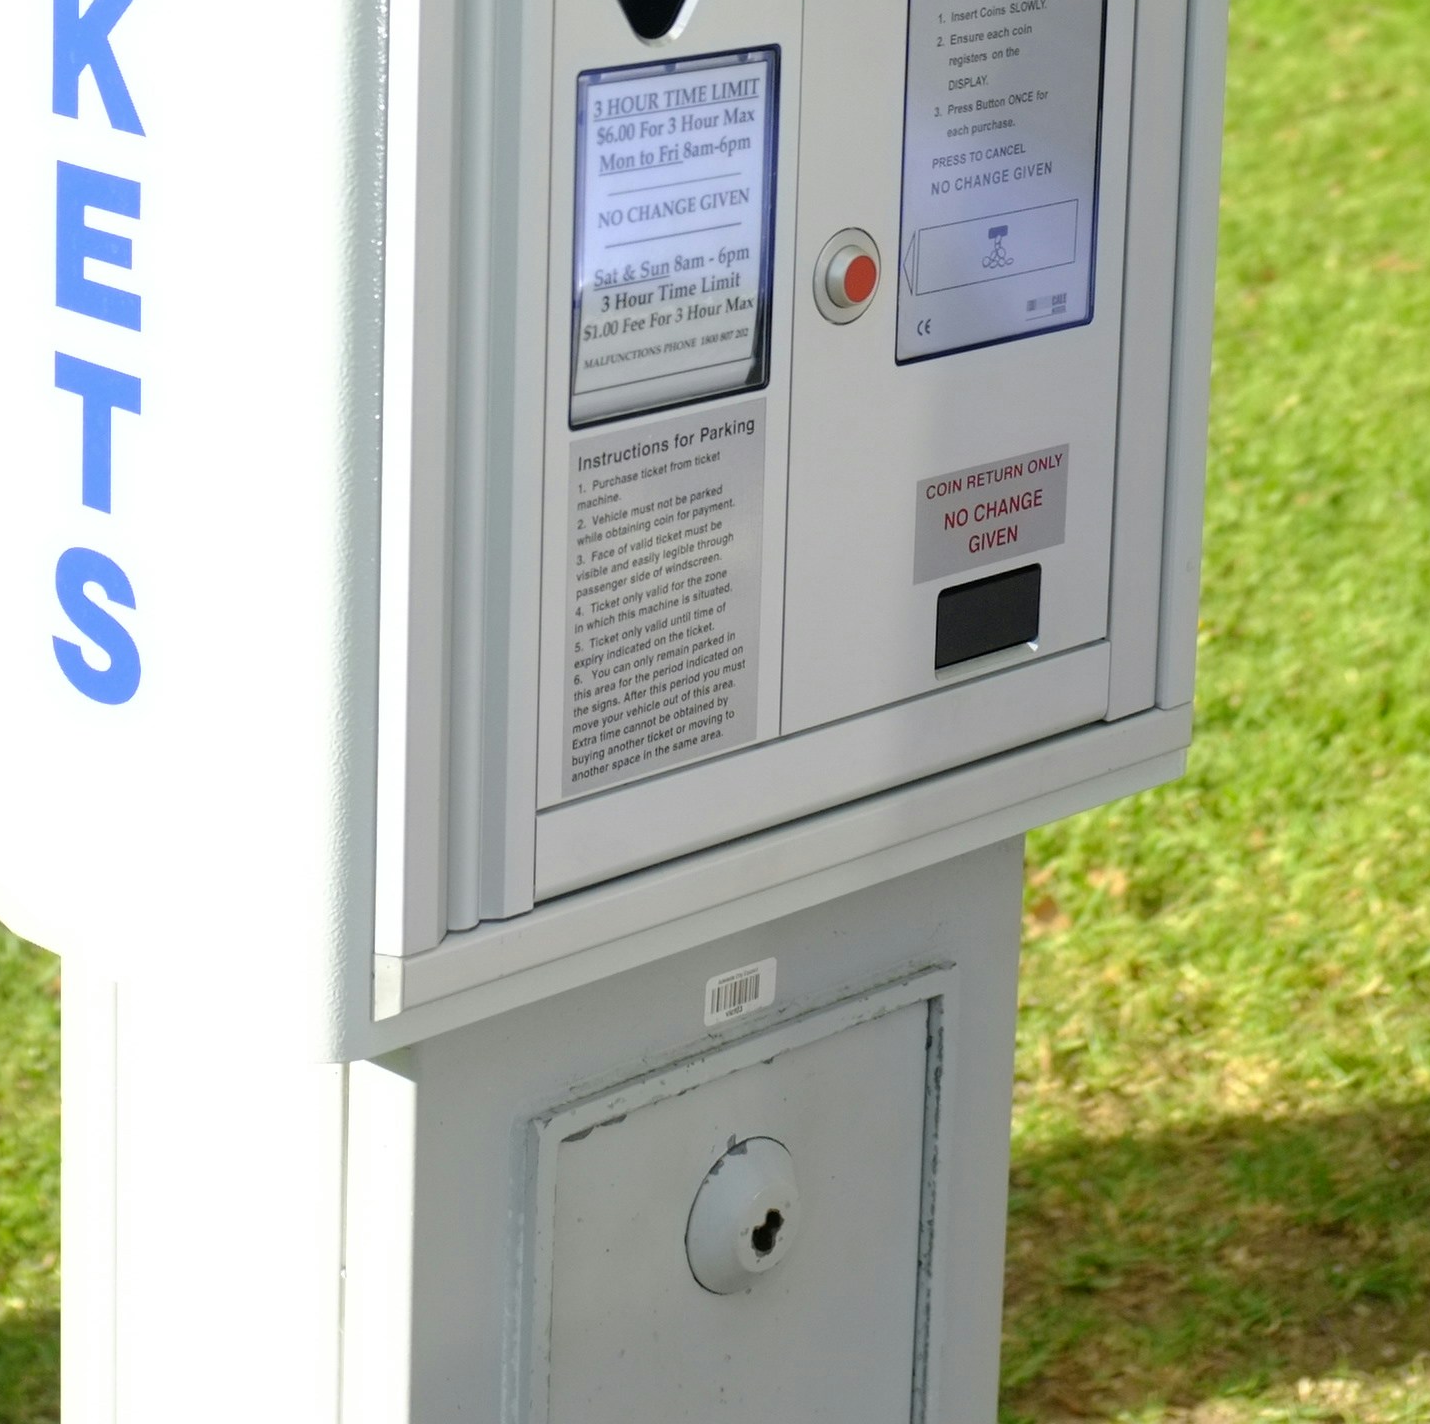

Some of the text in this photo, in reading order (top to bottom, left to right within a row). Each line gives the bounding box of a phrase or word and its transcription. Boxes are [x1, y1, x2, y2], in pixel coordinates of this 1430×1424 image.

[951, 9, 977, 22] Insert
[980, 6, 1006, 18] Coins
[1010, 0, 1047, 13] SLOWLY.
[951, 33, 984, 45] Ensure
[987, 27, 1009, 39] each
[1012, 25, 1032, 36] coin
[949, 46, 1020, 66] registers on the
[594, 78, 760, 117] 3 HOUR TIME LIMIT
[948, 104, 973, 115] Press
[976, 98, 1005, 110] Button
[1008, 92, 1033, 105] ONCE
[1036, 90, 1048, 100] for
[597, 109, 755, 146] $6.00 For 3 Hour Max
[947, 120, 1015, 137] each purchase.
[600, 137, 751, 171] Mon to Fri 8am-6pm
[932, 143, 1025, 168] PRESS TO CANCEL
[931, 162, 1052, 195] NO CHANGE GIVEN
[598, 188, 750, 227] NO CHANGE GIVEN
[594, 268, 617, 286] Sat
[623, 265, 635, 281] &
[641, 262, 669, 278] Sun
[674, 256, 704, 272] 8am
[718, 247, 749, 267] 6pm
[601, 272, 740, 312] 3 Hour Time Limit
[583, 298, 754, 342] $1.00 Fee For 3 Hour Max
[583, 345, 661, 369] MALFUNCTIONS
[663, 338, 697, 353] PHONE
[579, 421, 755, 471] Instructions for Parking
[592, 473, 638, 490] Purchase
[641, 463, 667, 478] ticket
[670, 460, 691, 471] from
[695, 450, 720, 466] ticket
[926, 453, 1062, 500] COIN RETURN ONLY
[577, 494, 621, 510] machine.
[945, 489, 1042, 530] NO CHANGE
[969, 525, 1018, 553] GIVEN
[573, 659, 745, 717] the signs. After this period you must
[574, 646, 743, 701] this area for the period indicated on
[573, 681, 735, 733] move your vehicle out of this area.
